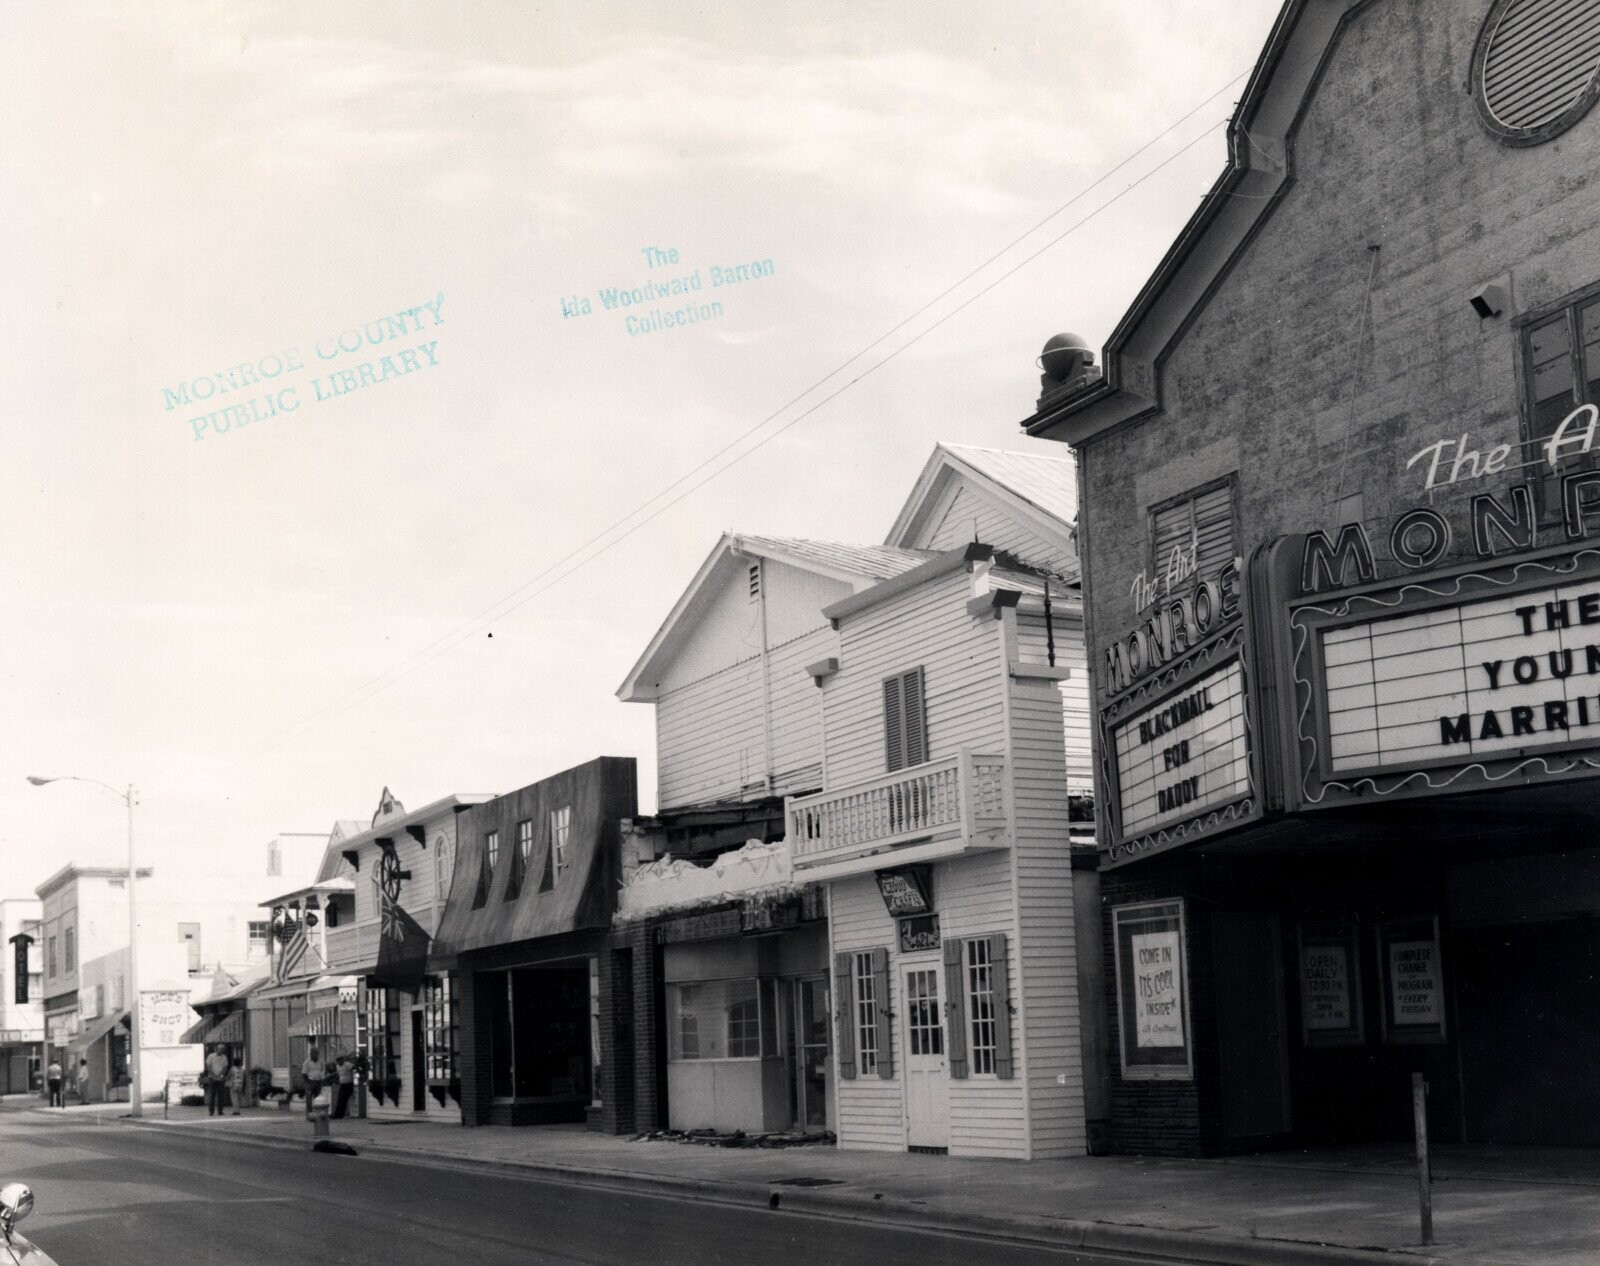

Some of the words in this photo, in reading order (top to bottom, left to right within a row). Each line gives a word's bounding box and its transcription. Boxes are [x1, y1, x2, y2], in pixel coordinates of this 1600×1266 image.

[1407, 433, 1511, 489] The
[1130, 568, 1158, 615] The
[1166, 527, 1200, 595] Art
[1105, 557, 1242, 697] MONROE
[1516, 593, 1600, 635] THE
[1139, 687, 1214, 744] BLACKMAIL
[1440, 694, 1600, 745] MARRI
[1163, 740, 1189, 771] FOR
[1158, 775, 1199, 813] DADDY
[894, 892, 922, 908] CRAFTS
[1139, 947, 1159, 964] COME
[1162, 947, 1171, 962] IN
[1310, 955, 1337, 967] OPEN
[1155, 969, 1174, 995] COOL
[1307, 968, 1338, 979] DAILY
[152, 1014, 182, 1024] SHOP
[1146, 1002, 1170, 1016] INSIDE
